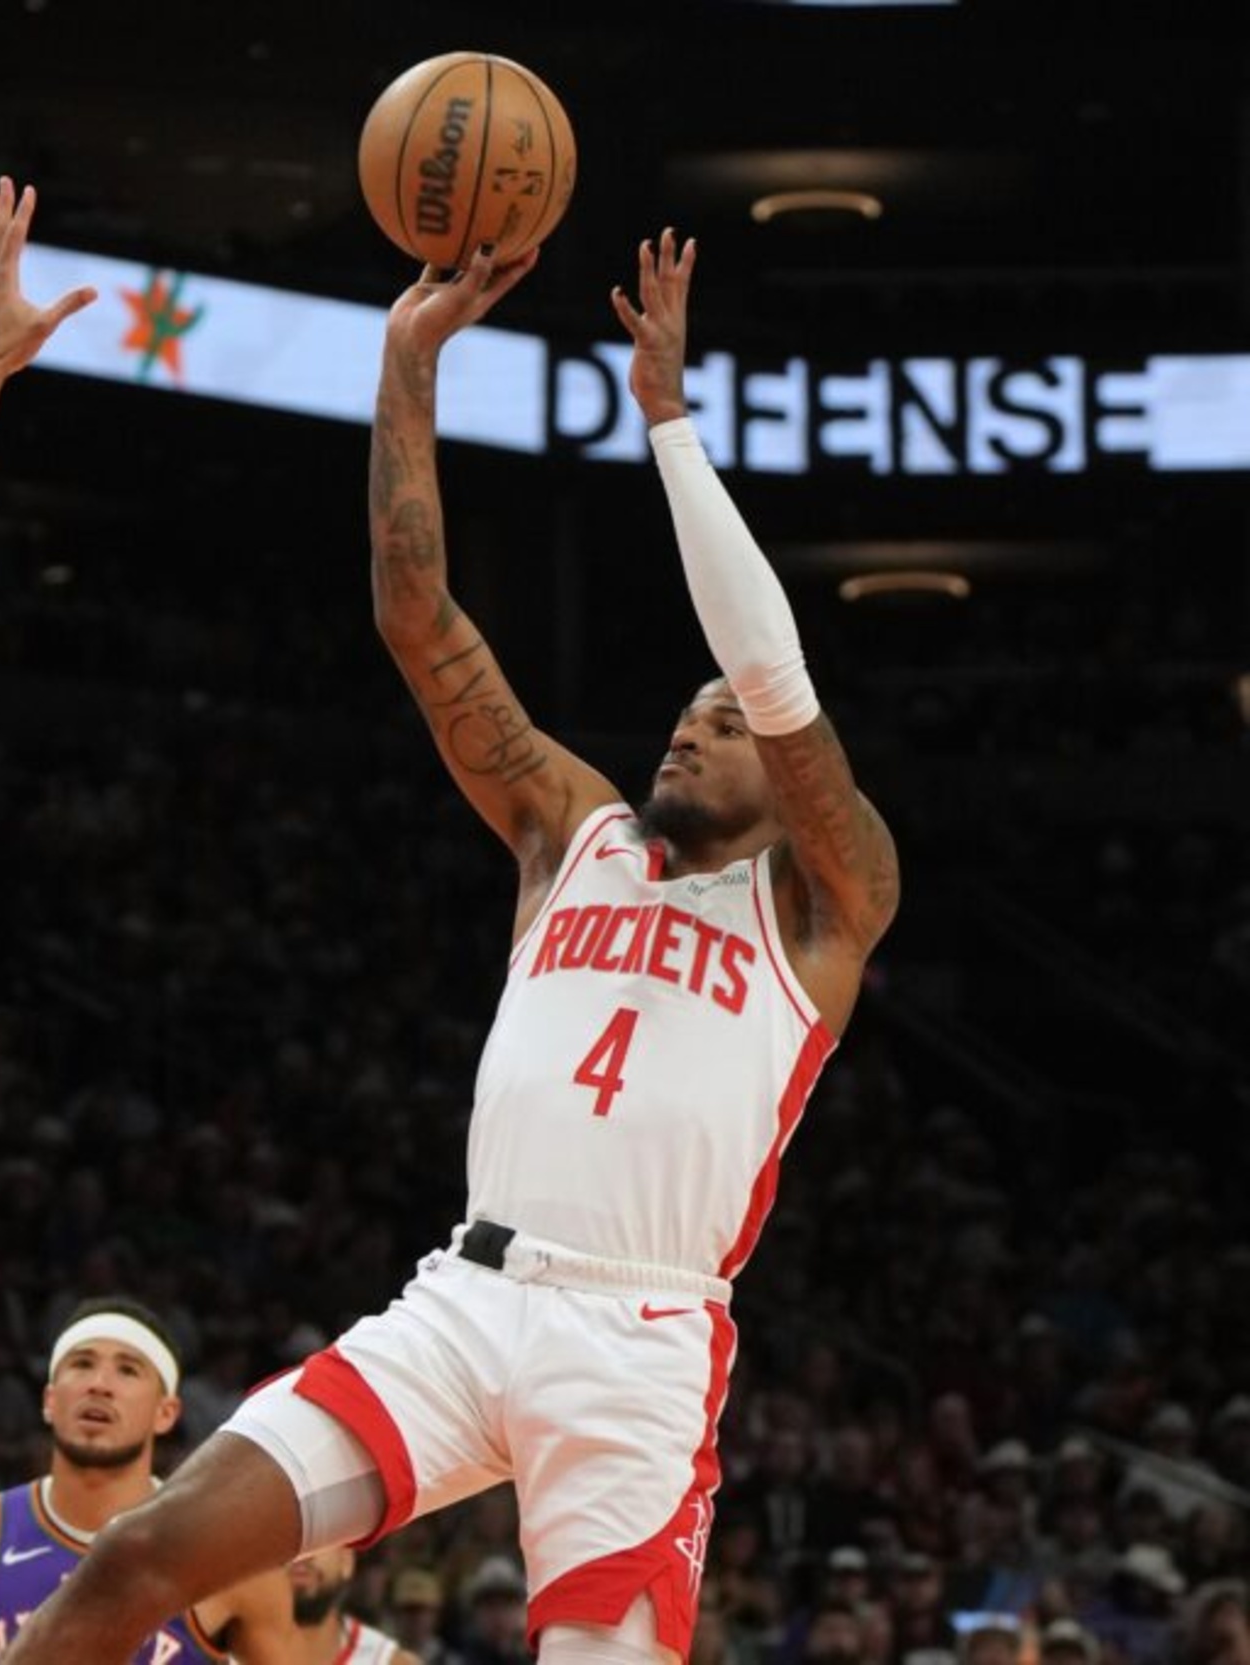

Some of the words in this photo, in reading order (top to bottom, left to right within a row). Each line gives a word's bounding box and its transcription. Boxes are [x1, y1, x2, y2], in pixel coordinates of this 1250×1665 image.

[416, 97, 473, 236] Wilson
[528, 902, 756, 1017] ROCKETS
[573, 1007, 639, 1118] 4
